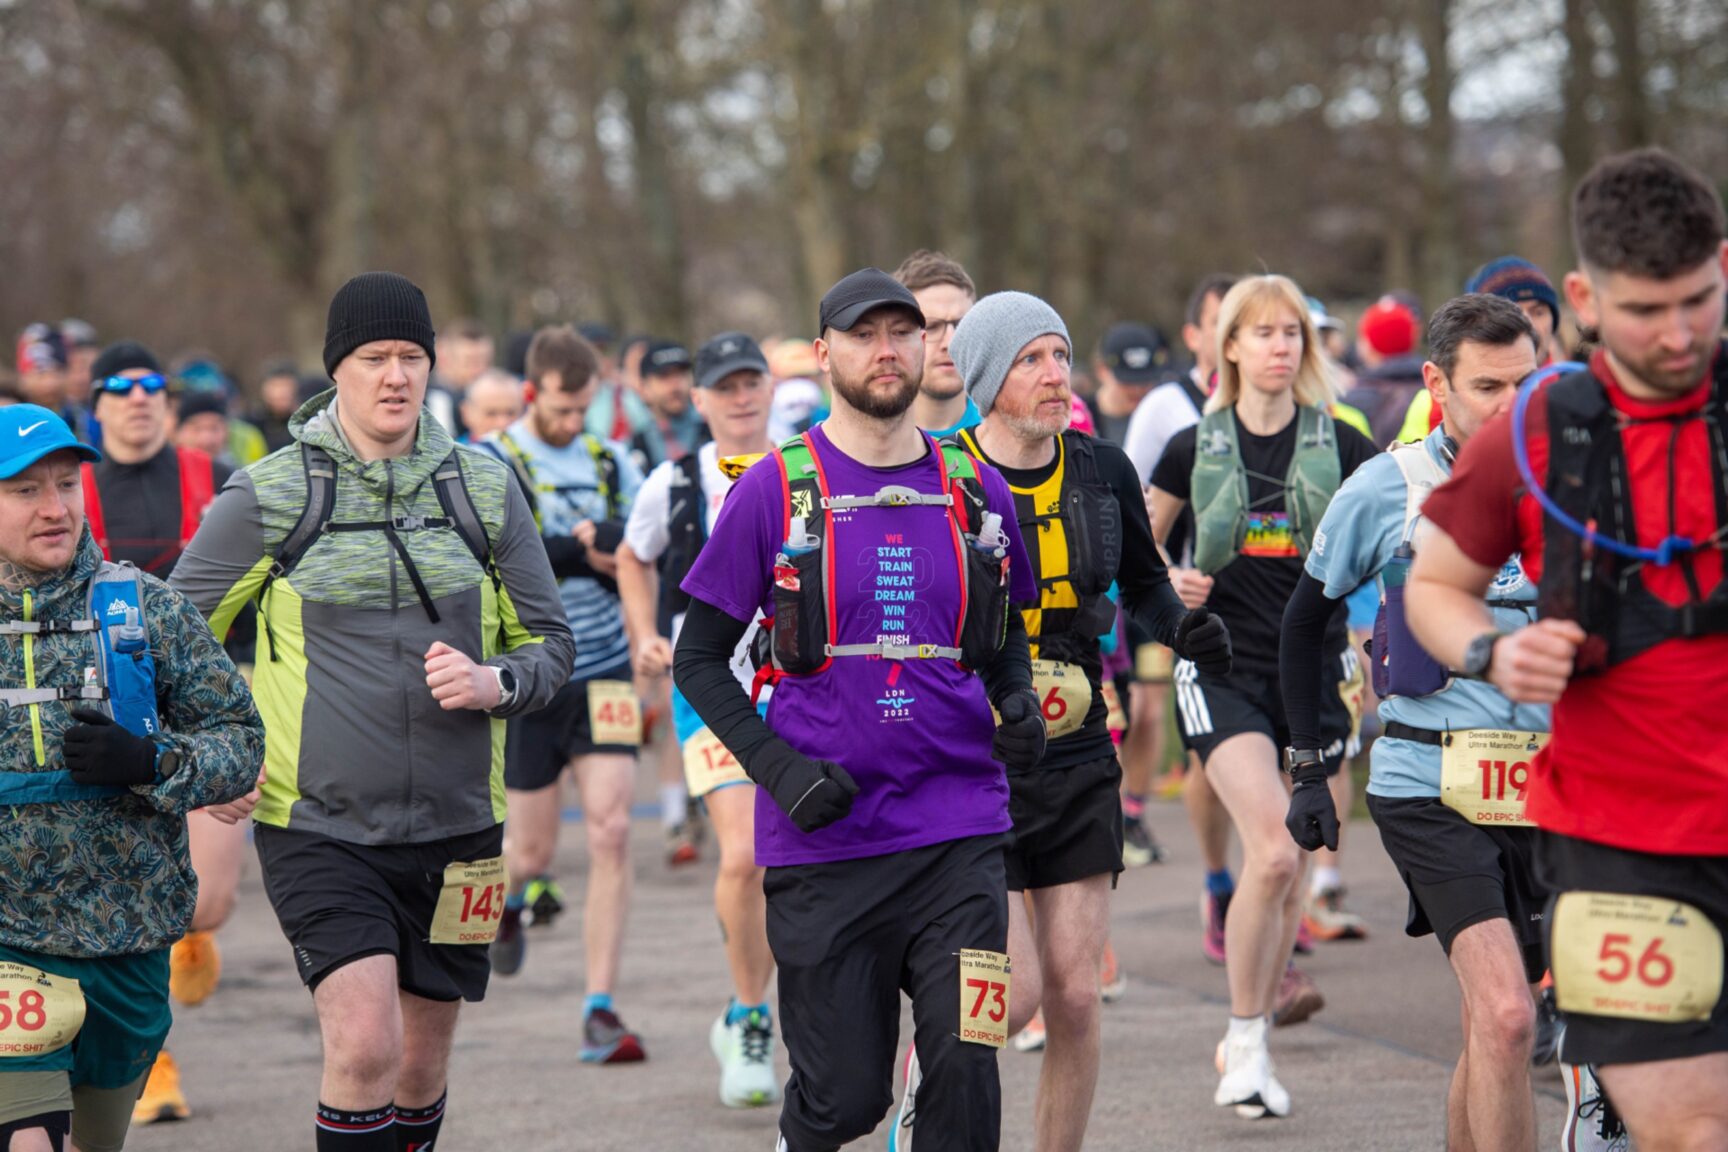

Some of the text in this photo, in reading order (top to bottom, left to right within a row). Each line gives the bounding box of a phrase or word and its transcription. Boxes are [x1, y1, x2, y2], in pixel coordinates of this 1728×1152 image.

[885, 534, 903, 544] WE
[1100, 499, 1117, 577] IPRUN
[877, 547, 912, 557] START
[878, 561, 912, 571] TRAIN
[876, 576, 914, 586] SWEAT
[875, 590, 915, 600] DREAM
[883, 605, 905, 616] WIN
[882, 620, 904, 630] RUN
[885, 689, 906, 698] LDN
[1033, 686, 1067, 721] 6
[597, 701, 635, 727] 48
[884, 708, 910, 717] 2022
[1468, 732, 1517, 740] Deeside Way
[1478, 760, 1530, 801] 119
[1494, 813, 1514, 821] EPIC
[461, 883, 505, 922] 143
[986, 953, 998, 961] Way
[1597, 933, 1674, 987] 56
[8, 964, 24, 972] Way
[975, 961, 1002, 971] Marathon
[967, 978, 1006, 1022] 73
[964, 1030, 976, 1038] DO
[978, 1032, 992, 1040] EPIC
[23, 1044, 44, 1052] SHIT
